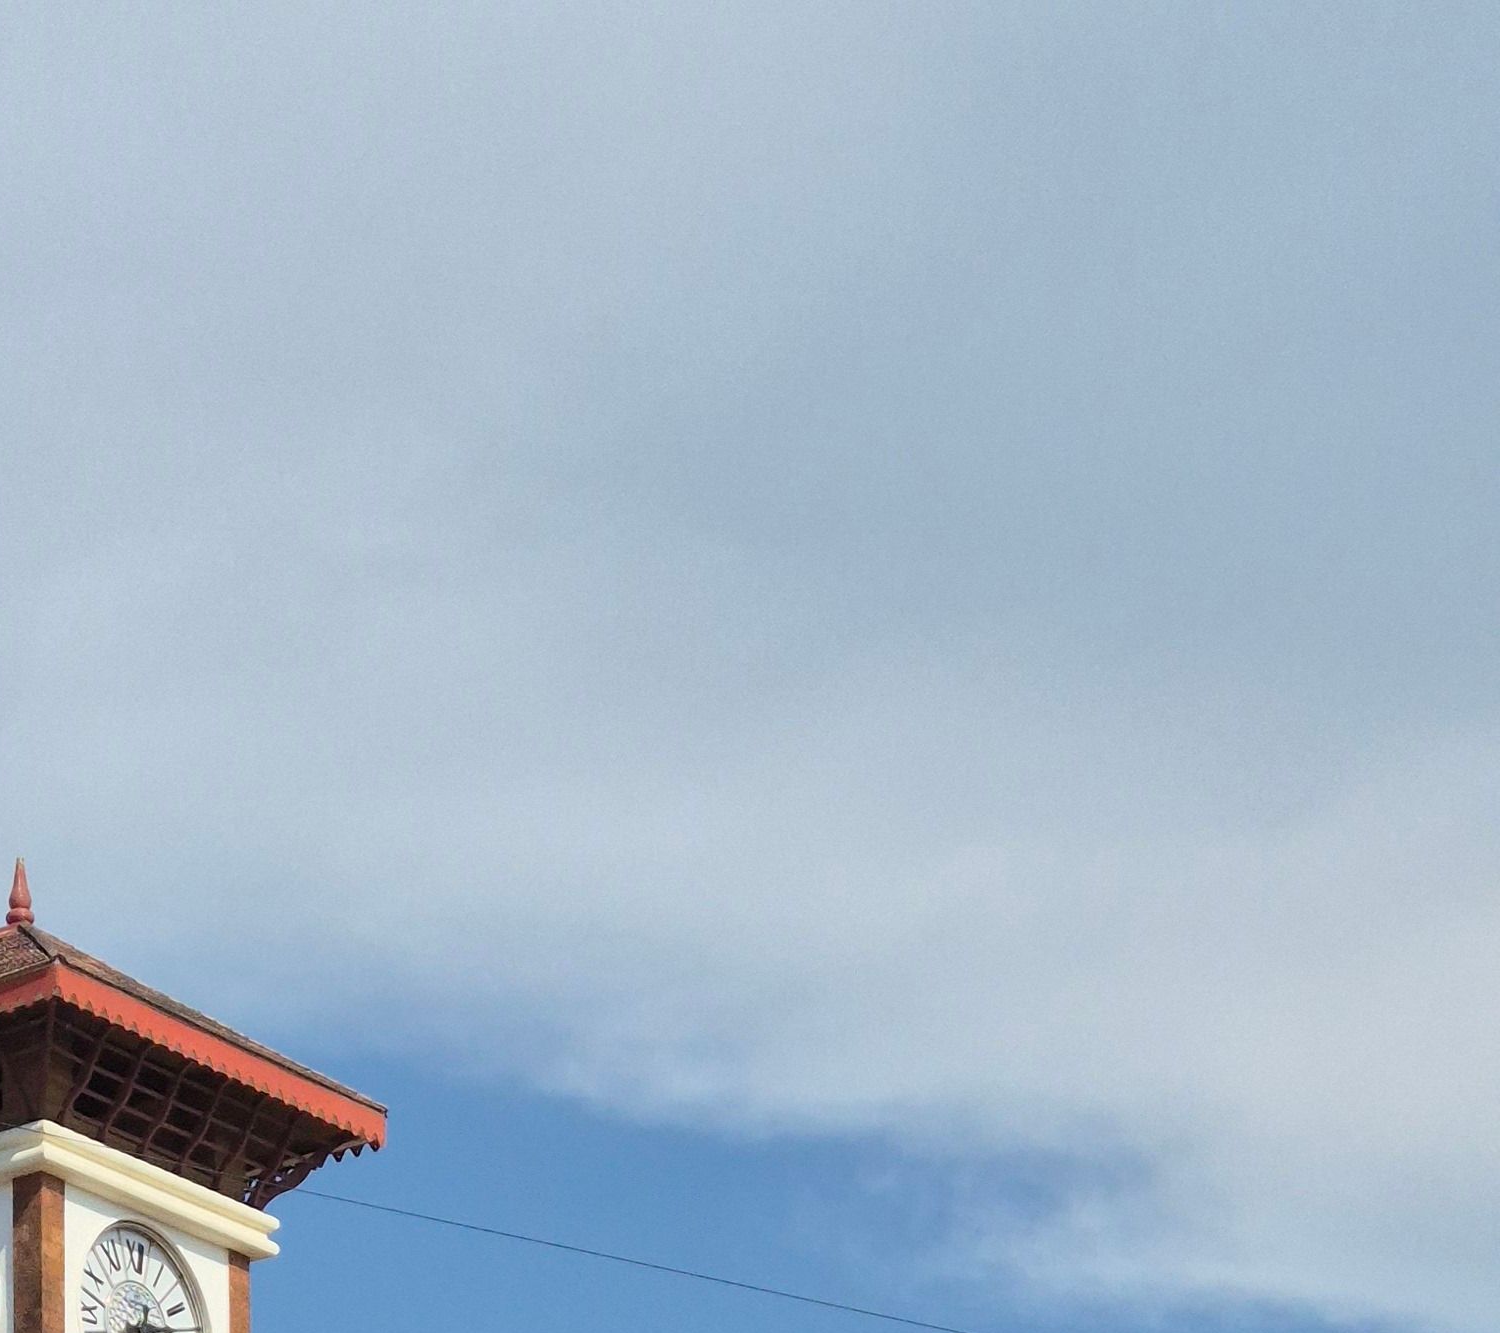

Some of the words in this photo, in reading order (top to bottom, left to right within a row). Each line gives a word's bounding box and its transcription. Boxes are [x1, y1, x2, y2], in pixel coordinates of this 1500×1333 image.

[101, 1238, 121, 1275] XI
[126, 1238, 145, 1275] XII
[83, 1261, 104, 1292] X
[153, 1264, 164, 1287] I
[81, 1301, 98, 1325] IX
[166, 1301, 185, 1317] II
